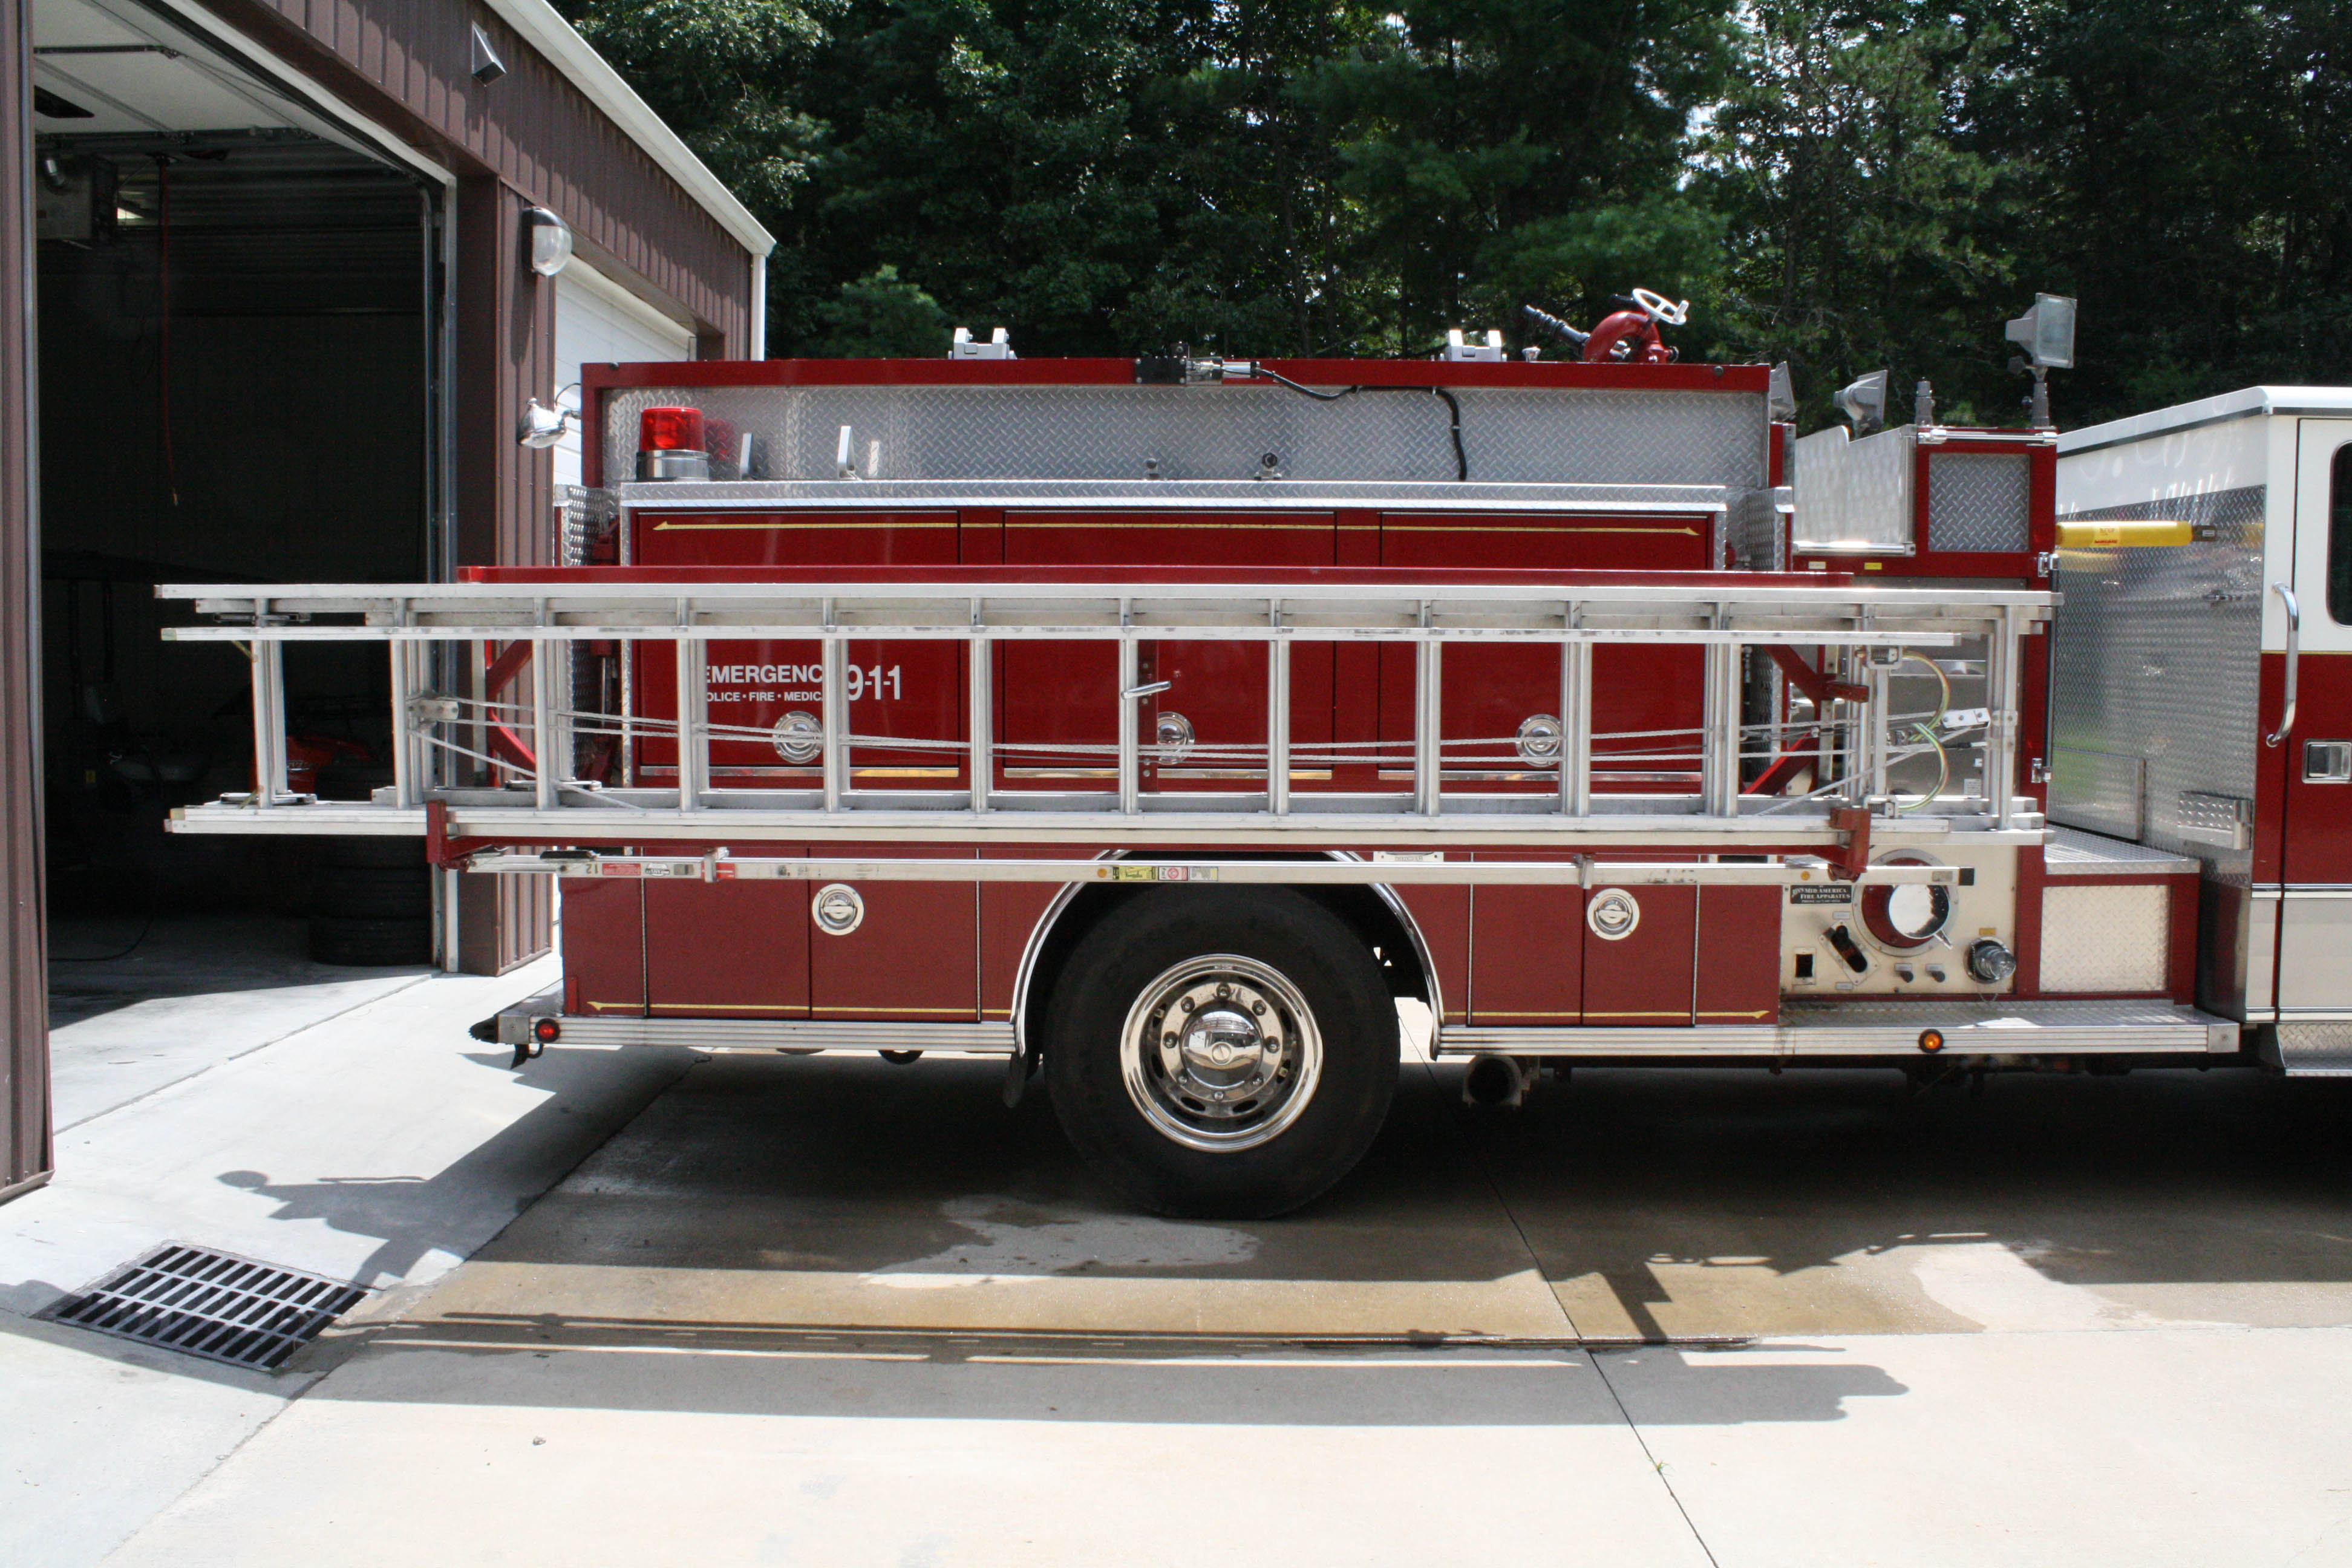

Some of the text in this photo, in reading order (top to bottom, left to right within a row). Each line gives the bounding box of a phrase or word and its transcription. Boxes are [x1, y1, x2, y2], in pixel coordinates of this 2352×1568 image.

[707, 664, 901, 701] MERGENC 9-1-1
[707, 691, 823, 702] OLICE FIRE MEDIC
